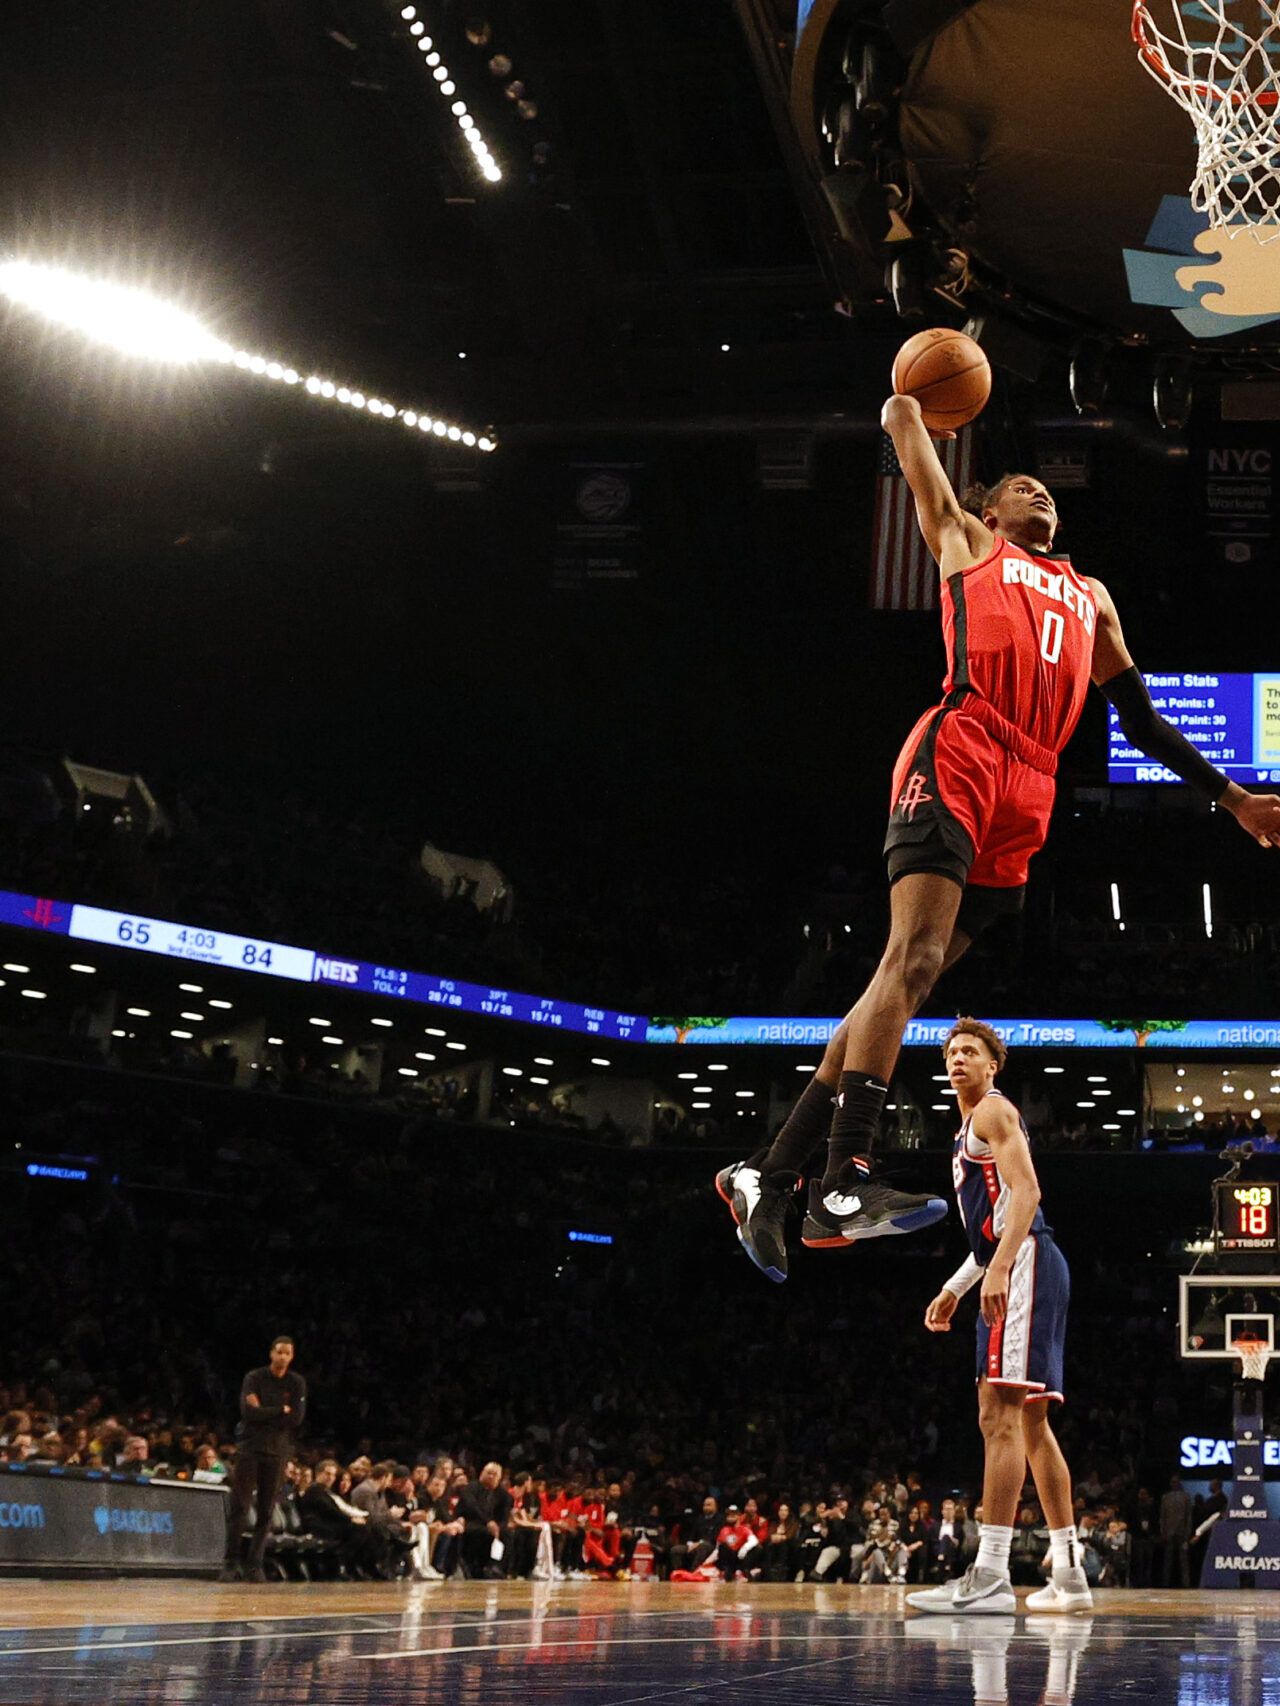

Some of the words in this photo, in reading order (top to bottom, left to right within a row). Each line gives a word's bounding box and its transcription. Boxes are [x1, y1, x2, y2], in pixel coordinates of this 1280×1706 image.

[1208, 448, 1272, 474] NYC
[1002, 558, 1095, 637] ROCKETS
[1041, 610, 1065, 664] 0
[1143, 674, 1180, 687] Team
[1183, 674, 1219, 687] Stats
[1169, 698, 1206, 709] Points:
[1266, 701, 1278, 709] to
[1181, 715, 1211, 726] Paint:
[1213, 715, 1226, 726] 30
[1110, 731, 1127, 741] 2n
[1213, 732, 1226, 742] 17
[1222, 749, 1235, 759] 21
[118, 920, 150, 944] 65
[177, 930, 216, 949] 4:03
[241, 944, 272, 967] 84
[314, 958, 360, 983] NETS
[758, 1022, 838, 1040] national
[907, 1023, 951, 1041] Thre
[990, 1024, 1014, 1041] or
[1020, 1024, 1076, 1042] Trees
[1234, 1187, 1272, 1206] 4:03
[1241, 1206, 1267, 1234] 18
[1237, 1239, 1276, 1248] TISSOT
[1229, 1509, 1268, 1519] BARCLAYS
